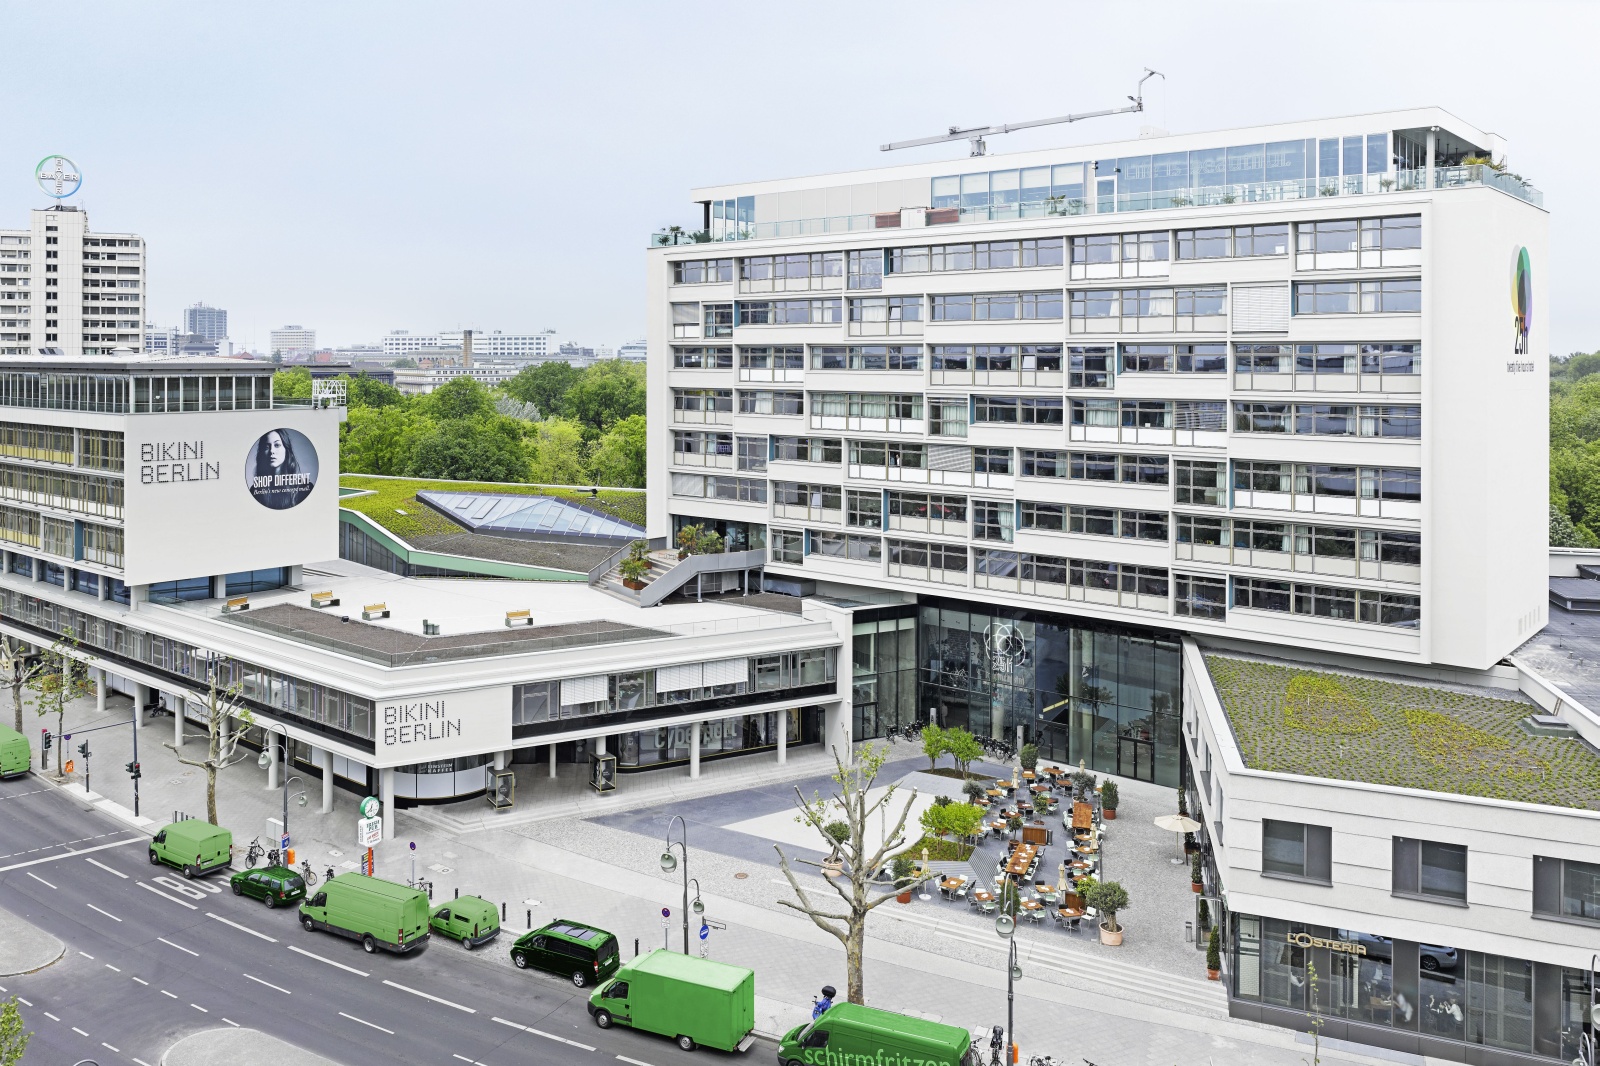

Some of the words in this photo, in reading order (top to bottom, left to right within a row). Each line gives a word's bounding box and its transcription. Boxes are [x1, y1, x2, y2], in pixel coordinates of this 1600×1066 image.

[41, 172, 78, 181] BAYER
[55, 159, 63, 194] BAYER
[1514, 316, 1529, 355] 25h
[141, 440, 203, 462] BIKINI
[141, 461, 220, 484] BERLIN
[253, 475, 273, 488] SHOP
[274, 472, 311, 487] DIFFERENT
[384, 700, 445, 725] BIKINI
[384, 719, 461, 746] BERLIN
[654, 718, 738, 750] cybeport
[1287, 932, 1366, 955] L'OSTERIA
